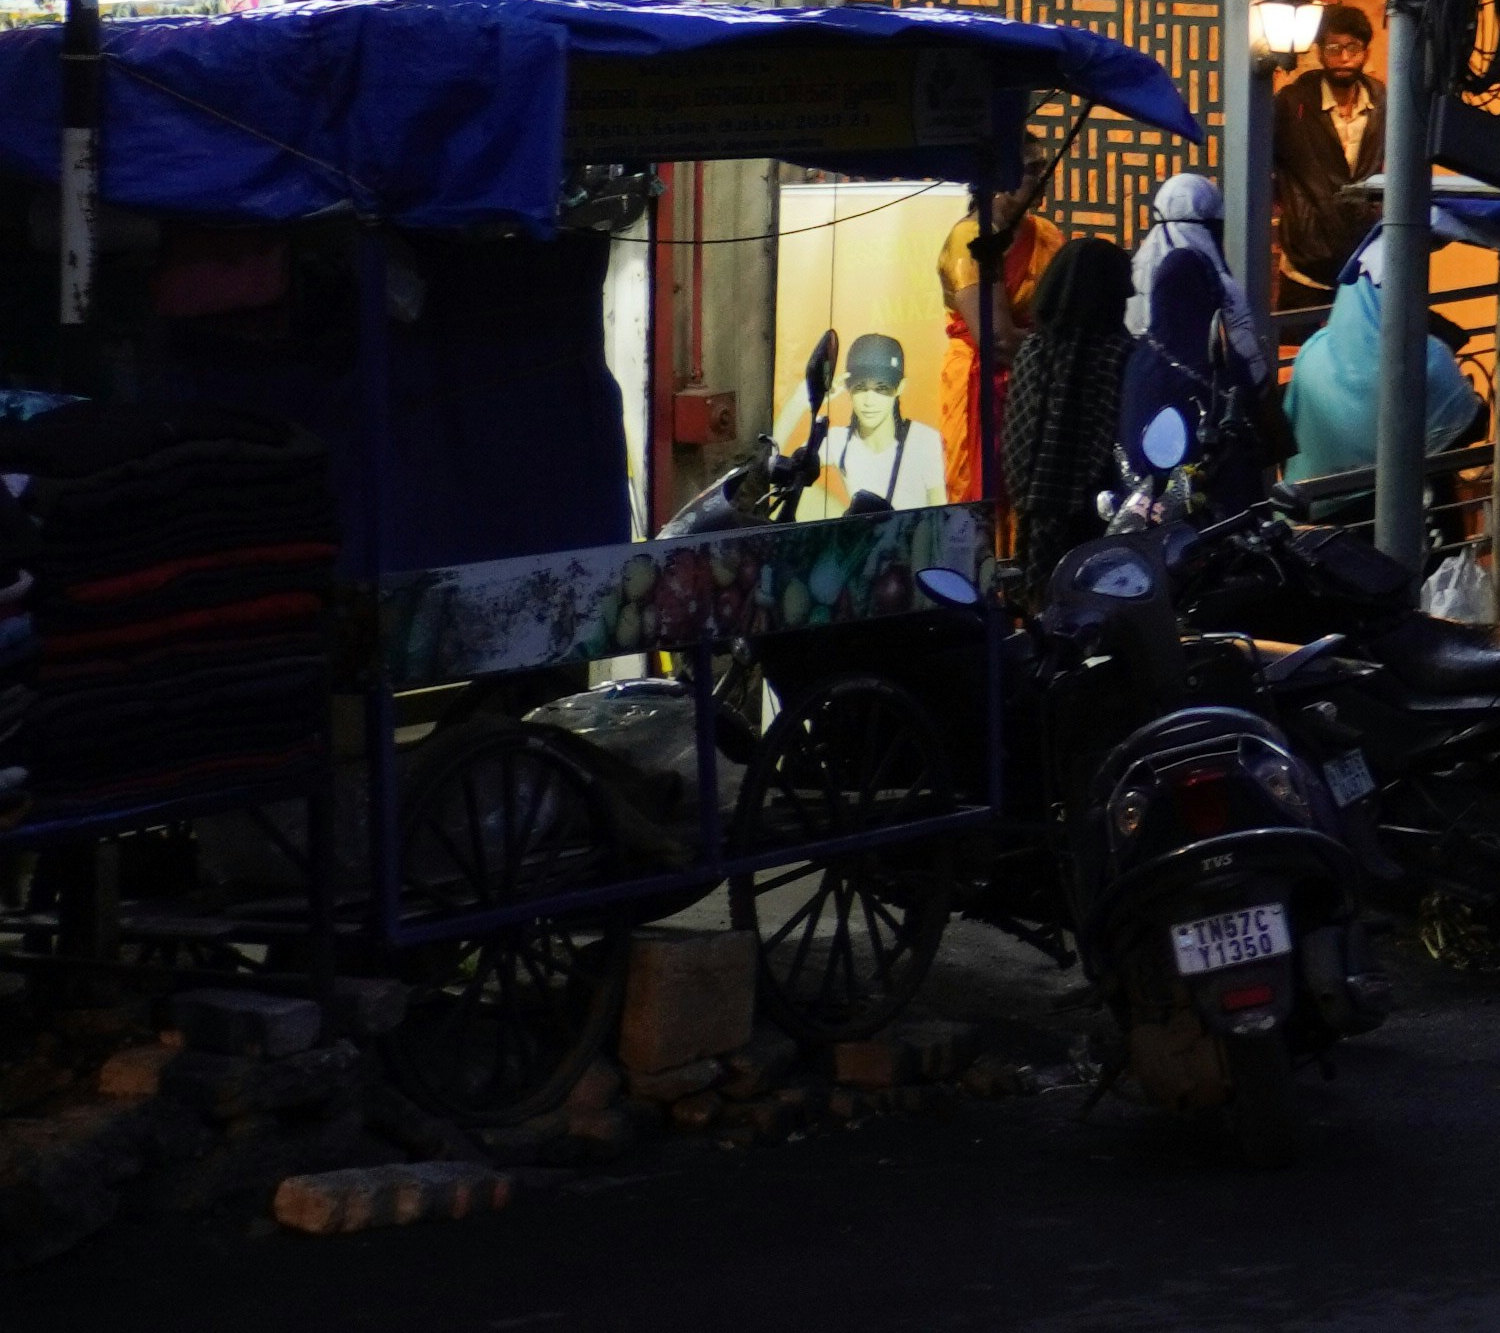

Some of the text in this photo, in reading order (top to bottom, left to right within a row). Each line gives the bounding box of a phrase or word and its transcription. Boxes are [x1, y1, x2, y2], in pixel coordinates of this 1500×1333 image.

[1201, 852, 1234, 871] TVS
[1192, 910, 1270, 945] TN57C
[1197, 934, 1273, 968] Y1350
